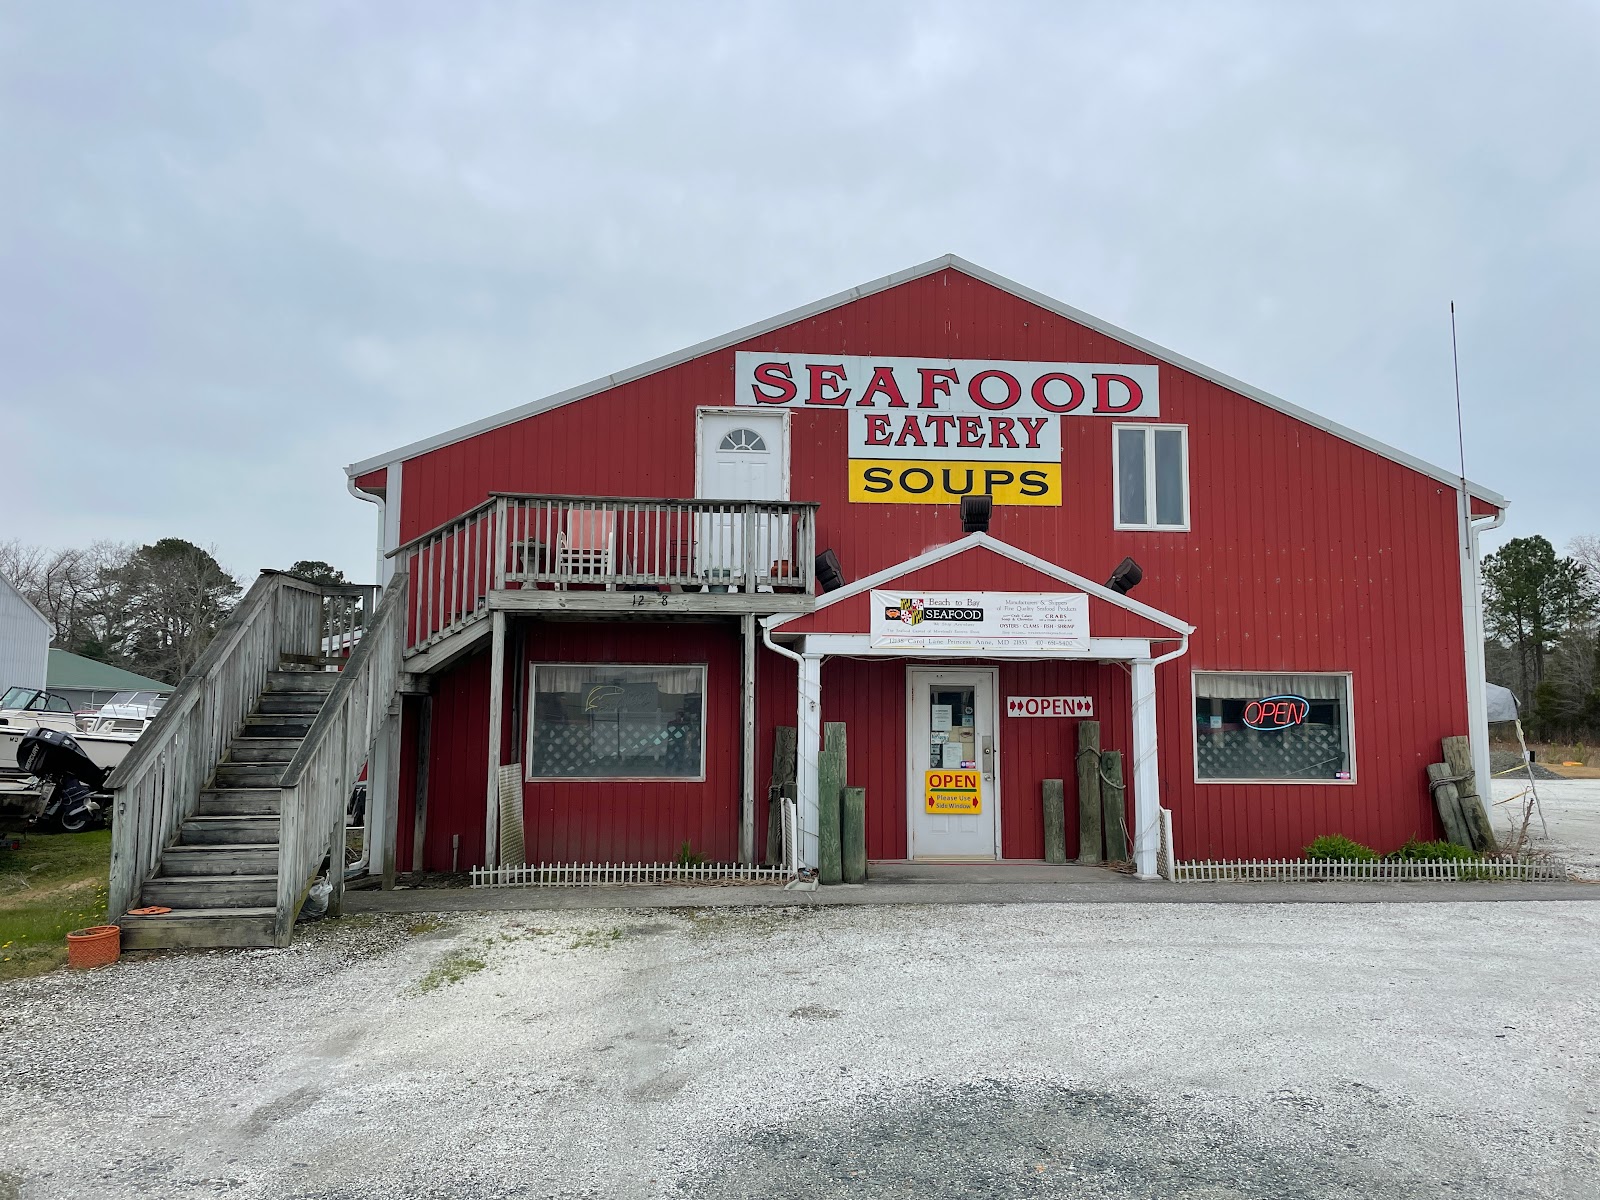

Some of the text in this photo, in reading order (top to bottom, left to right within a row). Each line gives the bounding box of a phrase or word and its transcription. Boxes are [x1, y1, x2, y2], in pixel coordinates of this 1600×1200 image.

[752, 362, 1144, 414] SEAFOOD
[864, 414, 1049, 448] EATERY
[864, 468, 1050, 496] SOUPS
[925, 610, 982, 619] SEAFOOD
[967, 599, 980, 607] Bay
[1025, 699, 1075, 715] OPEN
[1244, 701, 1304, 724] OPEN
[25, 743, 40, 770] MERCURY
[929, 775, 976, 787] OPEN
